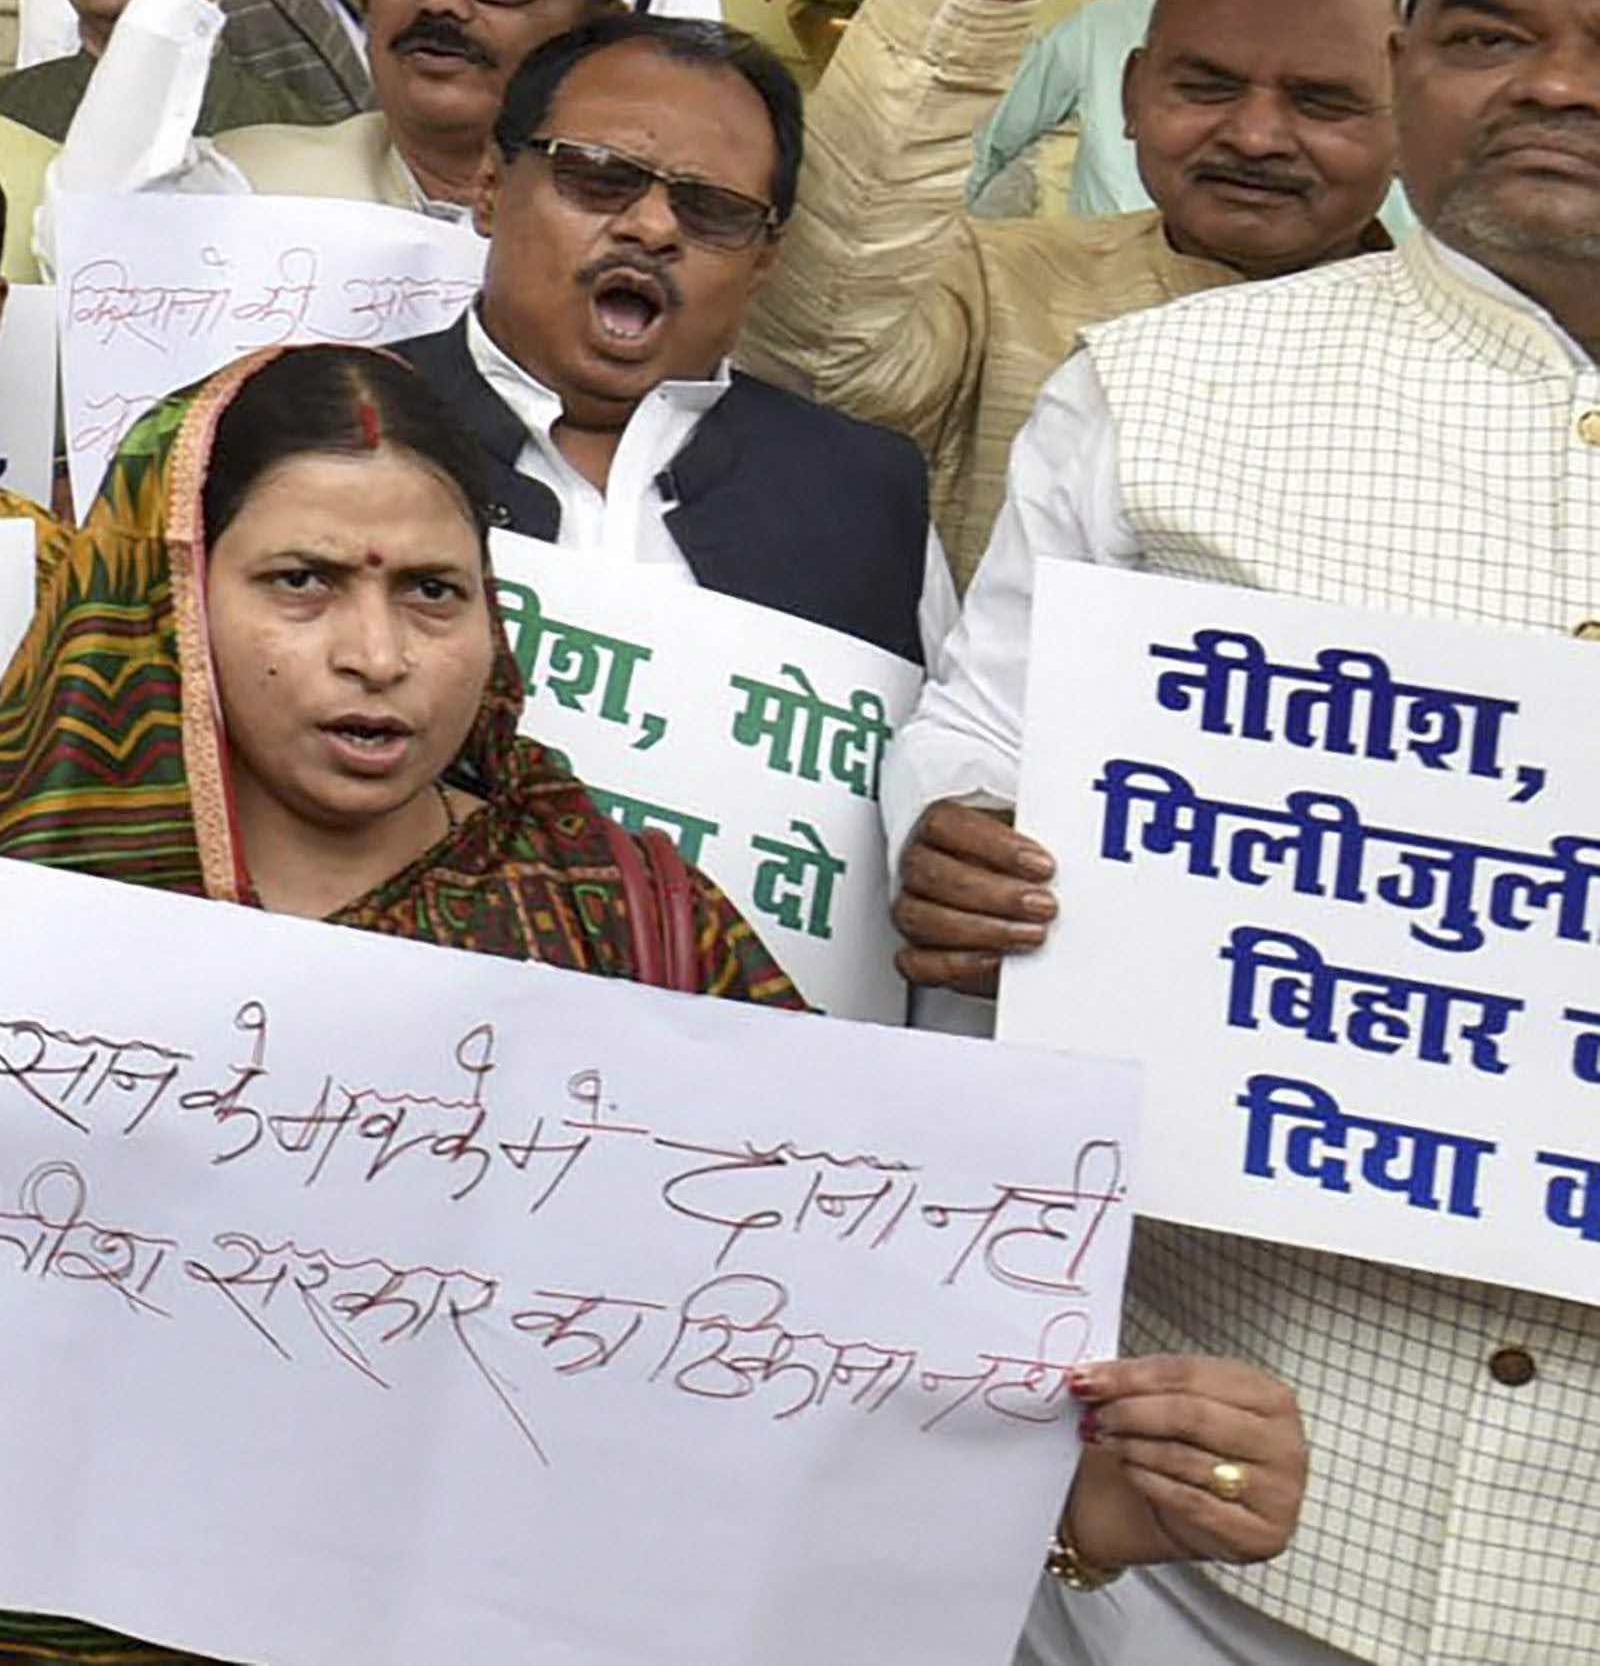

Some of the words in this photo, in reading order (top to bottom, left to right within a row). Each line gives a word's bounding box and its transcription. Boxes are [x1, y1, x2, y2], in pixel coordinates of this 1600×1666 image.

[1149, 629, 1547, 804] नीतीश,
[751, 820, 846, 940] दो
[1219, 925, 1526, 1074] बिहार
[180, 1000, 268, 1164] के
[654, 1140, 922, 1268] दाना
[1236, 1073, 1497, 1219] दिया
[512, 1290, 667, 1375] का
